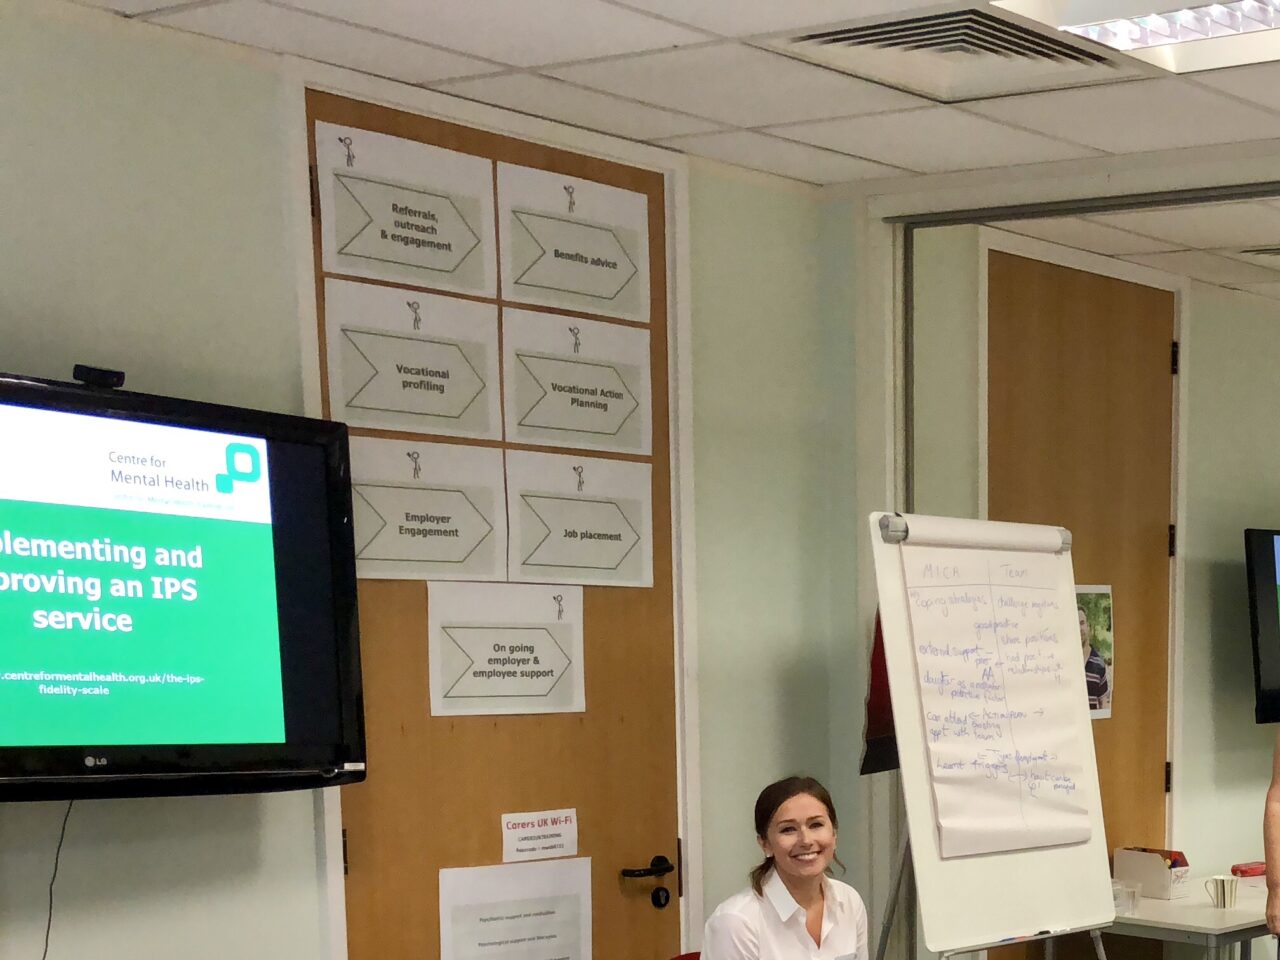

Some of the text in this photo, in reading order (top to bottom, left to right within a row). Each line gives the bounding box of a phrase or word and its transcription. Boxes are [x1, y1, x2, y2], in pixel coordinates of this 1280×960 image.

[391, 203, 438, 223] Referrals,
[394, 220, 437, 235] outreach
[380, 229, 453, 252] & engagement
[554, 249, 617, 269] Benefits advice
[396, 364, 449, 379] Vocational
[402, 380, 445, 394] profiling
[551, 382, 624, 400] Vocational Action
[571, 397, 608, 412] Planning
[109, 451, 166, 468] Centre for
[111, 470, 209, 492] Mental Health
[405, 512, 452, 524] Employer
[399, 525, 459, 538] Engagement
[563, 529, 622, 541] Job placement
[0, 530, 203, 569] lementing and
[110, 578, 143, 597] an
[151, 577, 198, 601] IPS
[33, 607, 133, 632] service
[493, 643, 534, 654] On going
[487, 656, 540, 667] employer &
[0, 671, 204, 685] .centreformentalhealth.org.uk/the-ips-
[472, 669, 554, 679] employee support
[39, 685, 110, 696] fidelity-scale
[506, 815, 572, 830] Carers UK Wi-Fi
